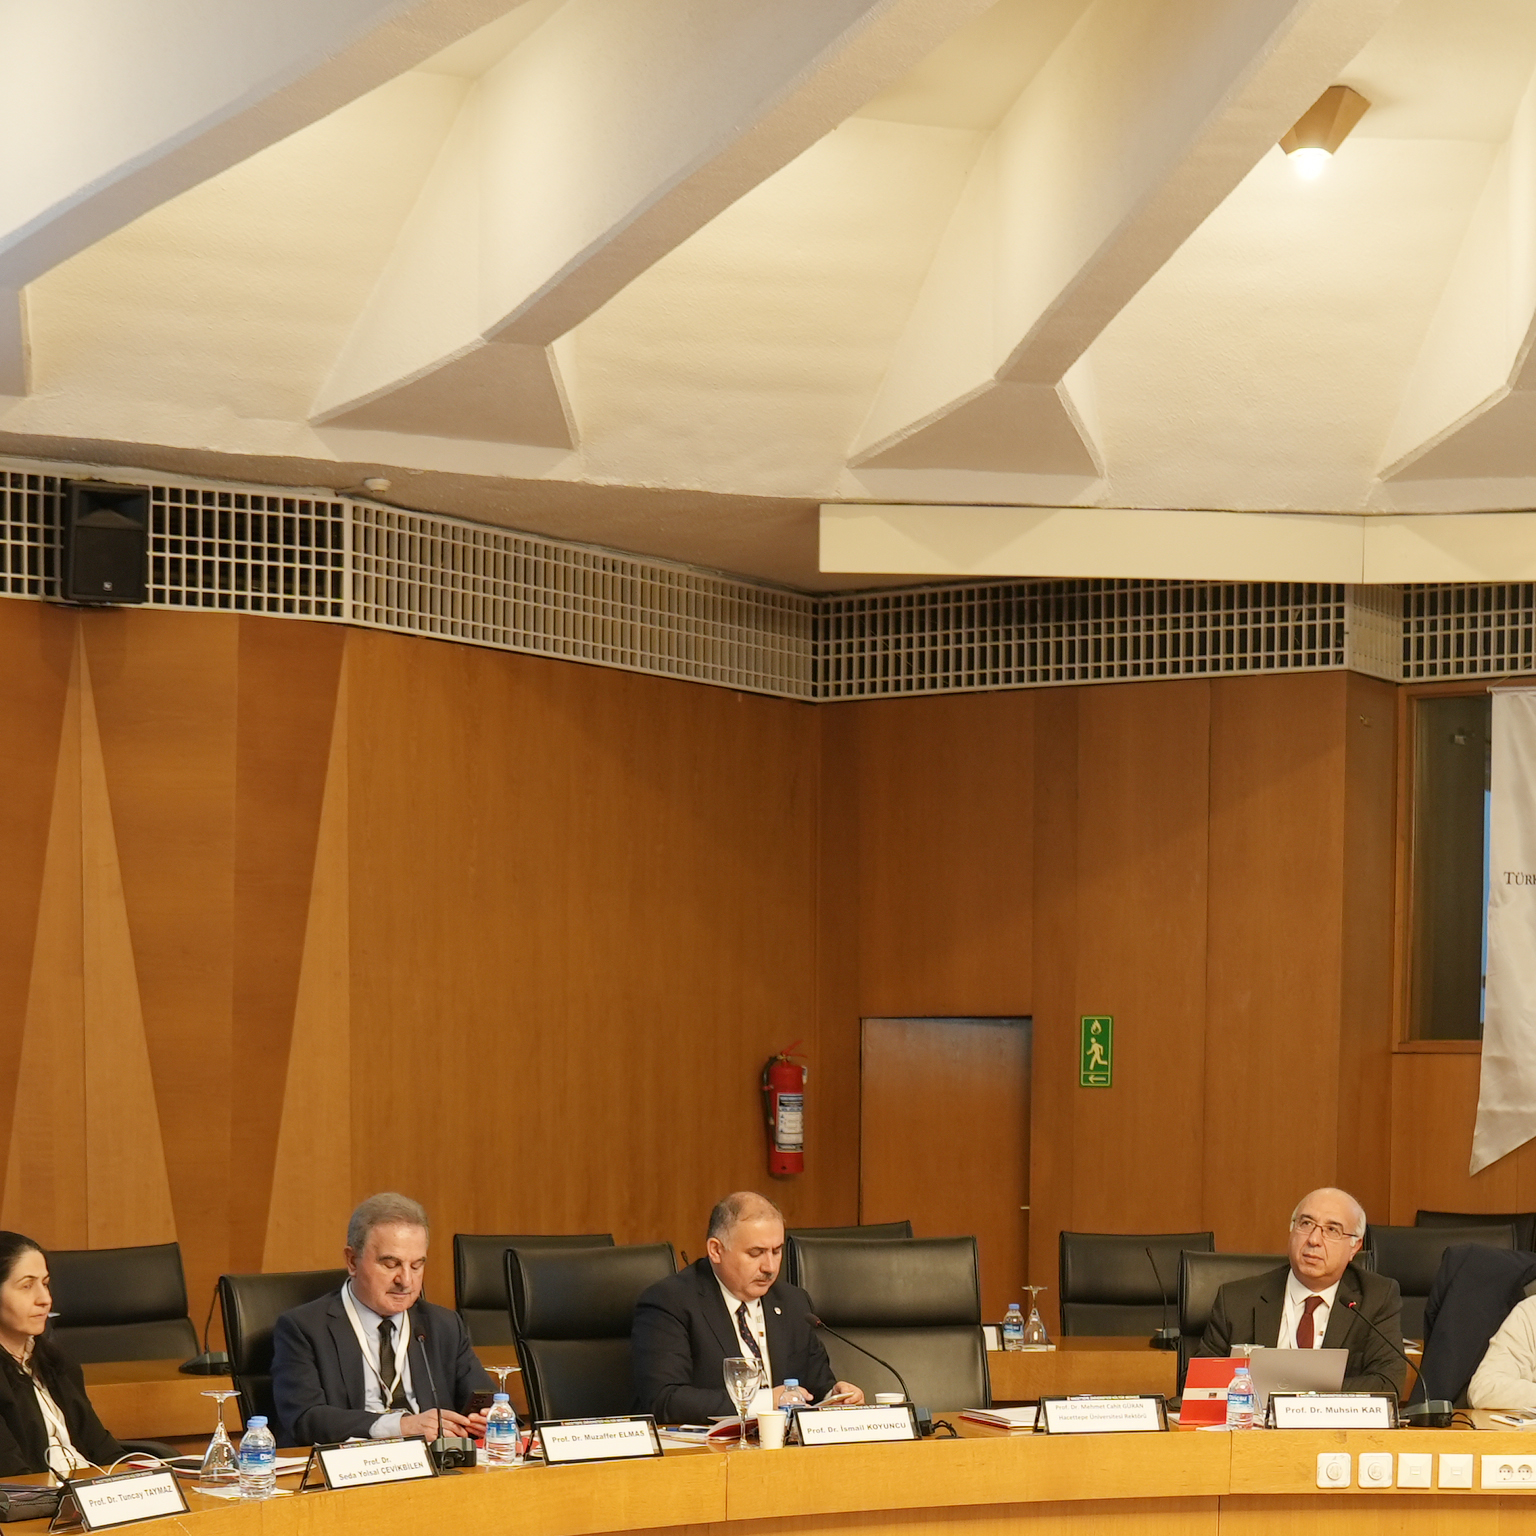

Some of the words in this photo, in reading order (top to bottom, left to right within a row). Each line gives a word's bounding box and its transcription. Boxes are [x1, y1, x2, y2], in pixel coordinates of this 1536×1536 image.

[1285, 1406, 1307, 1414] Prof.
[1310, 1406, 1322, 1414] Dr.
[1325, 1406, 1359, 1414] Muhsin
[1361, 1406, 1382, 1414] KAR
[827, 1425, 839, 1433] Dr.
[840, 1424, 865, 1432] İsmail
[867, 1422, 907, 1431] KOYUNCU
[552, 1434, 570, 1443] Prof.
[572, 1434, 583, 1442] Dr.
[584, 1432, 617, 1441] Muzaffer
[618, 1430, 645, 1438] ELMAS
[363, 1458, 380, 1466] Prof.
[381, 1456, 392, 1464] Dr.
[338, 1472, 357, 1481] Seda
[380, 1461, 424, 1475] ÇEVİKBİLEN
[89, 1498, 106, 1507] Prof.
[107, 1496, 117, 1504] Dr.
[119, 1491, 144, 1503] Tuncay
[144, 1485, 173, 1496] TAYMAZ
